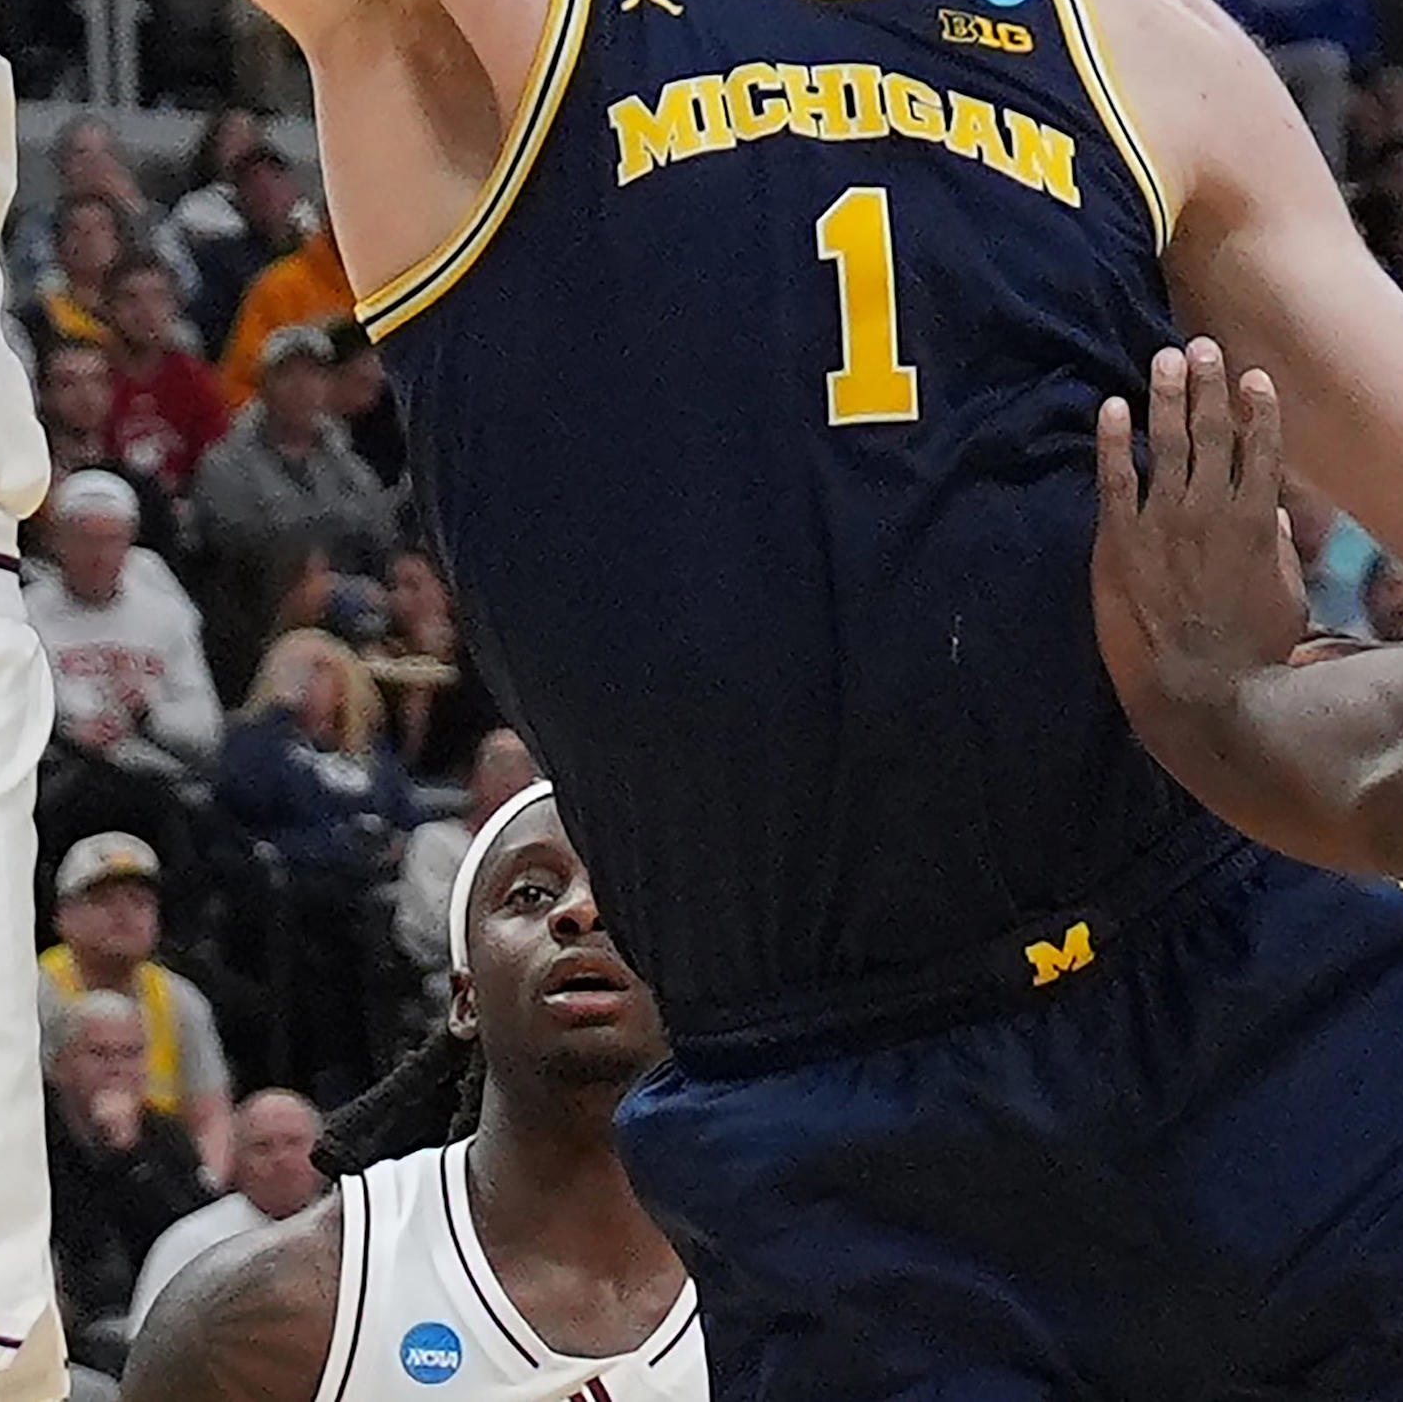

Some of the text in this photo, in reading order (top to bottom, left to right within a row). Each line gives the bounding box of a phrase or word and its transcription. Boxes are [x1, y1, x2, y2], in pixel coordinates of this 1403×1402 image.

[608, 62, 1082, 209] MICHIGAN
[815, 186, 920, 426] 1
[1024, 921, 1096, 987] M
